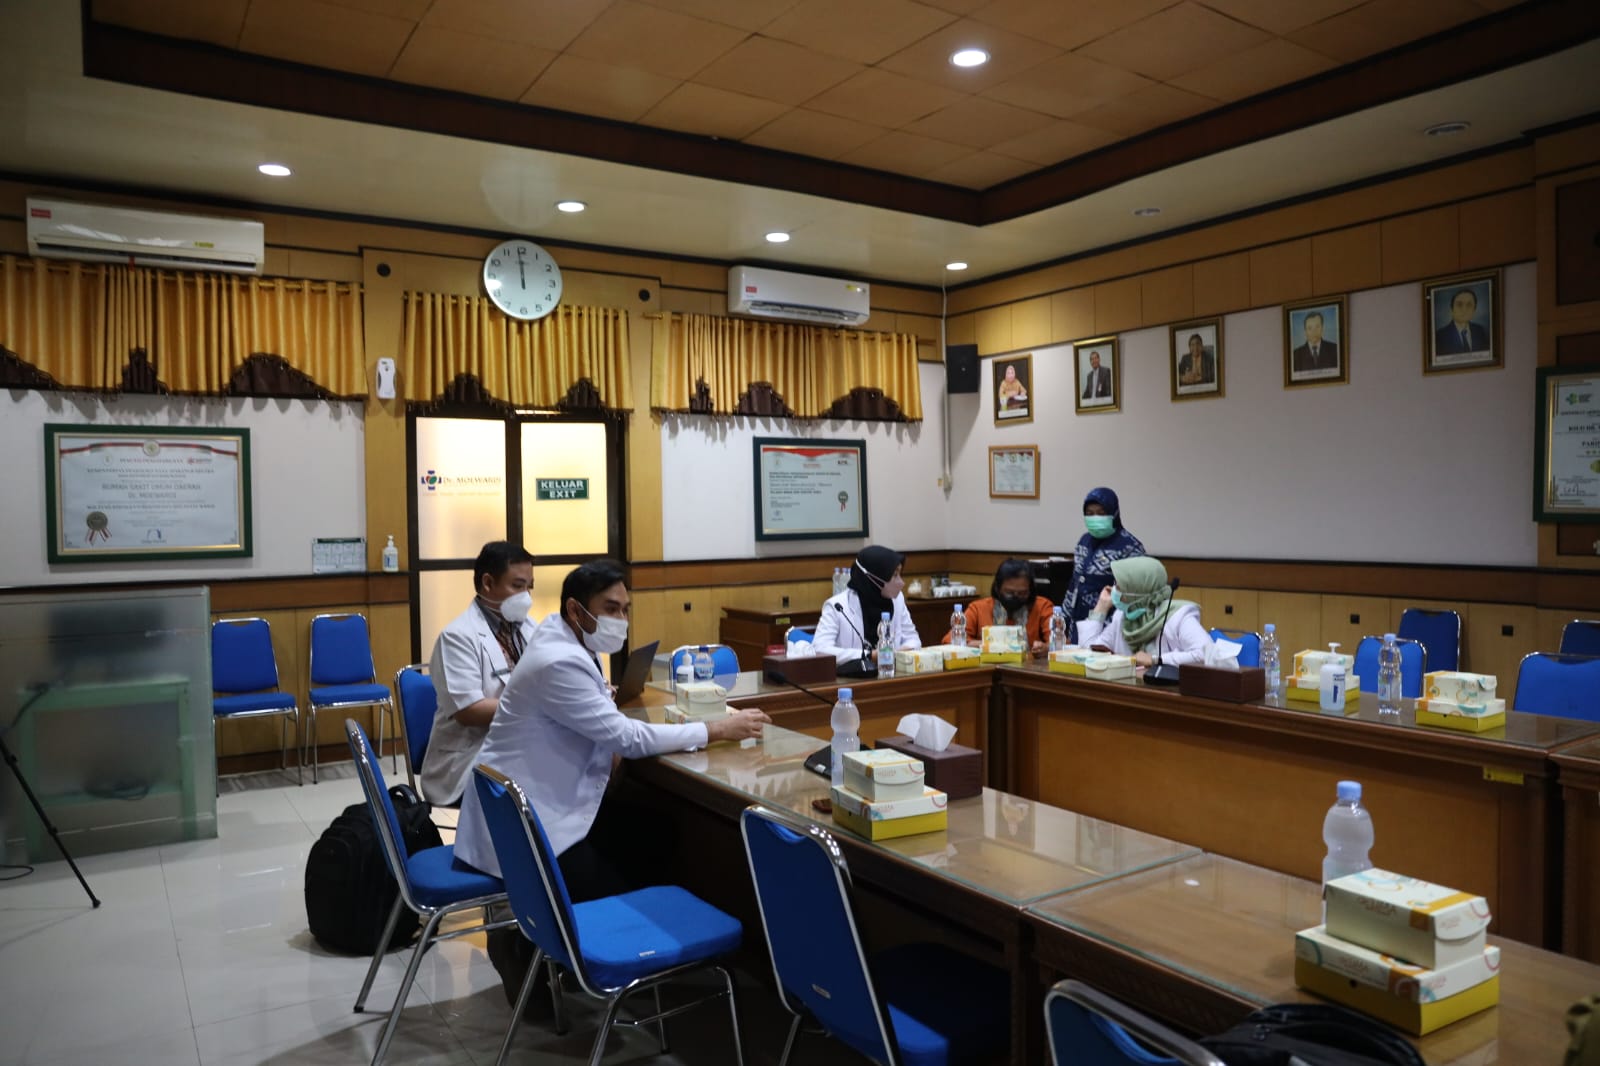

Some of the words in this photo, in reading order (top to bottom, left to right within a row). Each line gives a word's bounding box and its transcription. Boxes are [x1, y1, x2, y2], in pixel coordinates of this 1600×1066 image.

[503, 248, 511, 256] 11
[491, 259, 501, 267] 10
[545, 264, 552, 273] 2
[549, 280, 556, 288] 3
[545, 293, 552, 301] 4
[520, 307, 528, 315] 6
[535, 304, 542, 312] 5
[541, 479, 584, 489] KELUAR
[549, 489, 577, 498] EXIT
